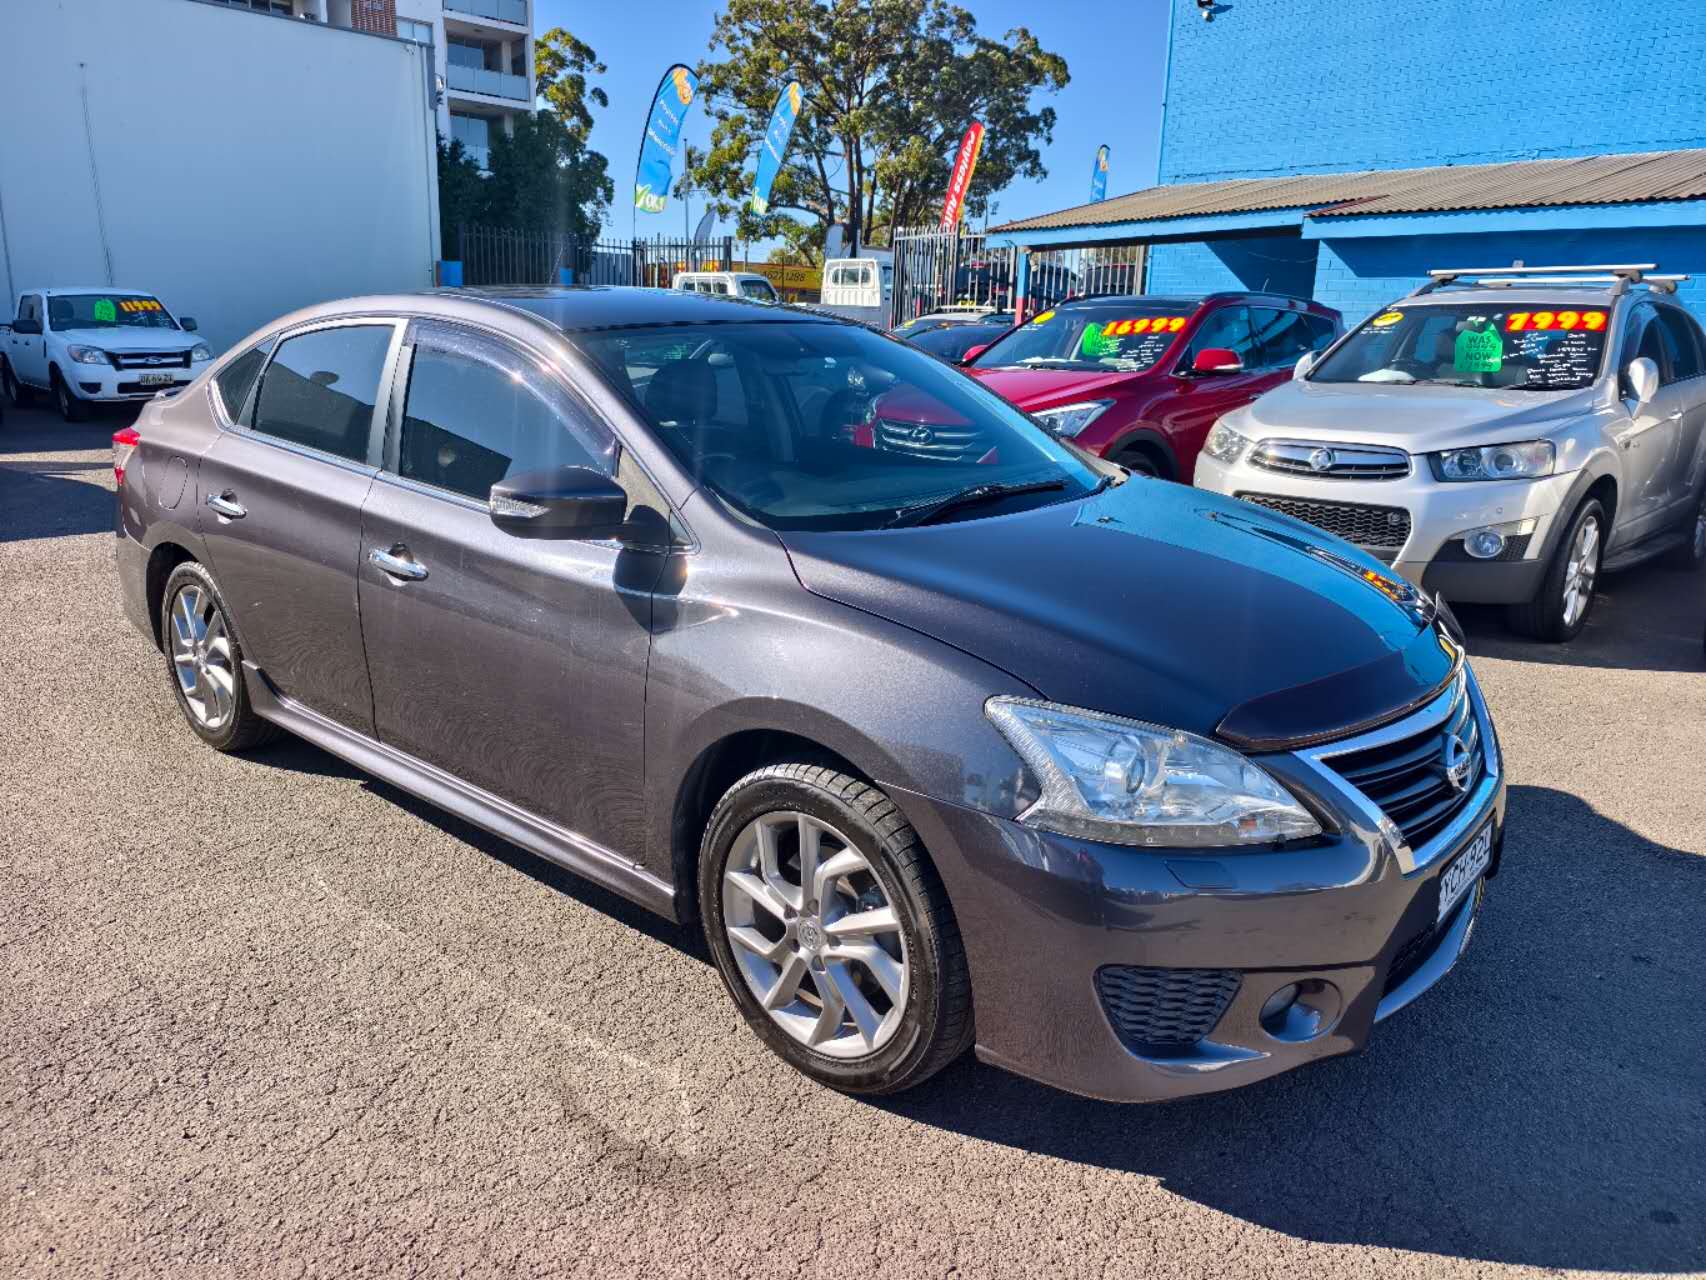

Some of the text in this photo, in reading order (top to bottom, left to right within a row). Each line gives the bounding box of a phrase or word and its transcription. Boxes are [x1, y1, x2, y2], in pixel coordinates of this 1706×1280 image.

[120, 300, 162, 312] 11999
[1101, 317, 1186, 336] 16999
[1508, 311, 1606, 331] 7999
[1468, 335, 1492, 344] WAS
[1466, 352, 1491, 361] NOW
